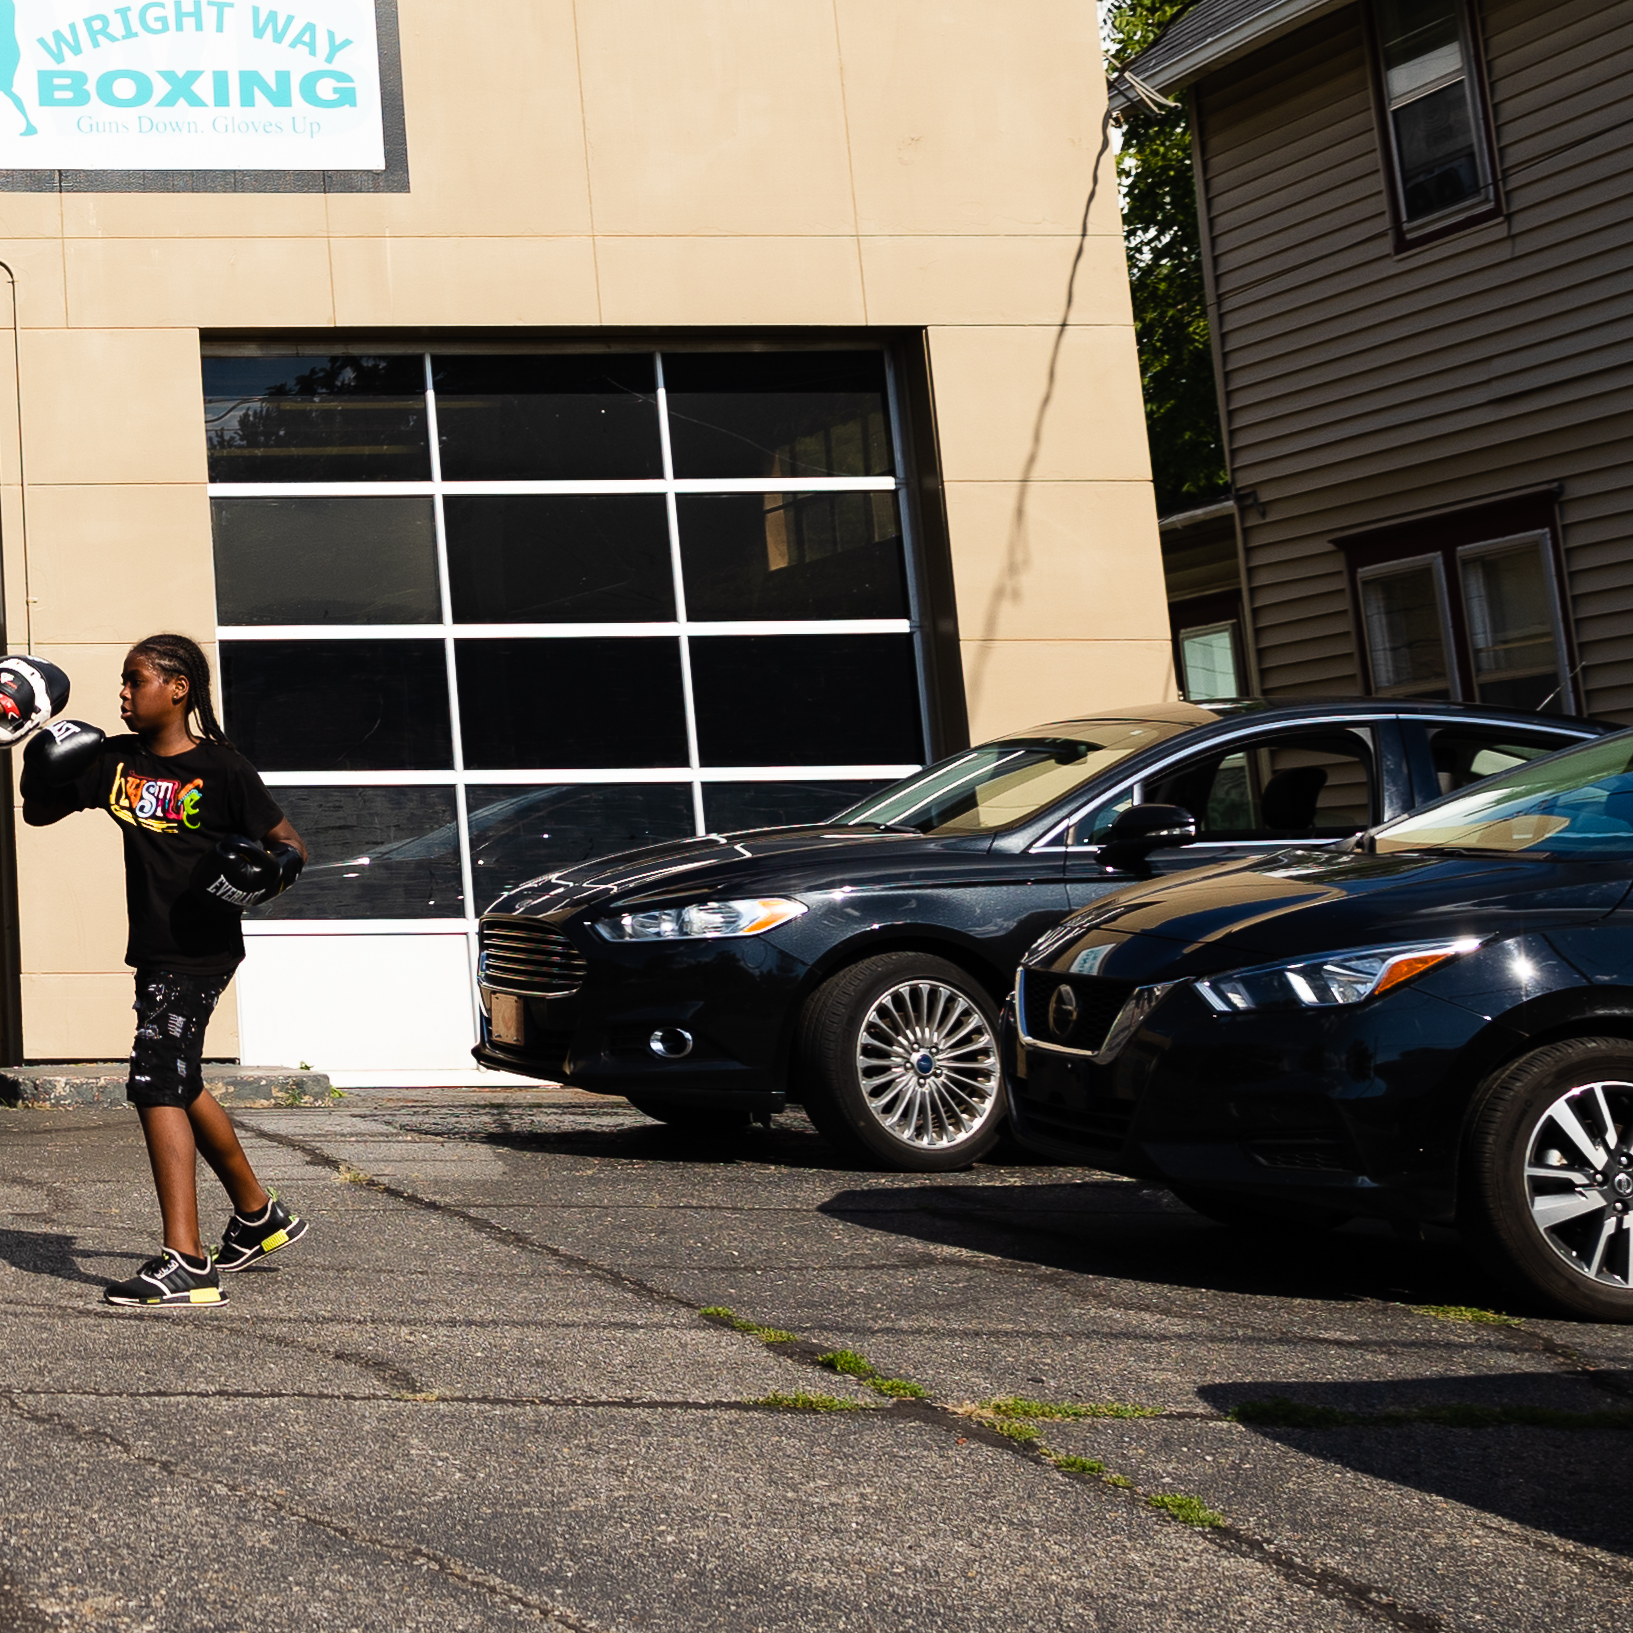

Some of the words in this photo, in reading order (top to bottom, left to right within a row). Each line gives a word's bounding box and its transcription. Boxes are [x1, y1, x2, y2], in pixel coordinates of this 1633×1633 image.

[36, 0, 235, 65] WRIGHT
[251, 5, 354, 65] WAY
[37, 69, 358, 109] BOXING
[76, 115, 130, 134] Guns
[137, 115, 204, 134] Down.
[212, 115, 284, 134] Gloves
[291, 116, 321, 138] Up
